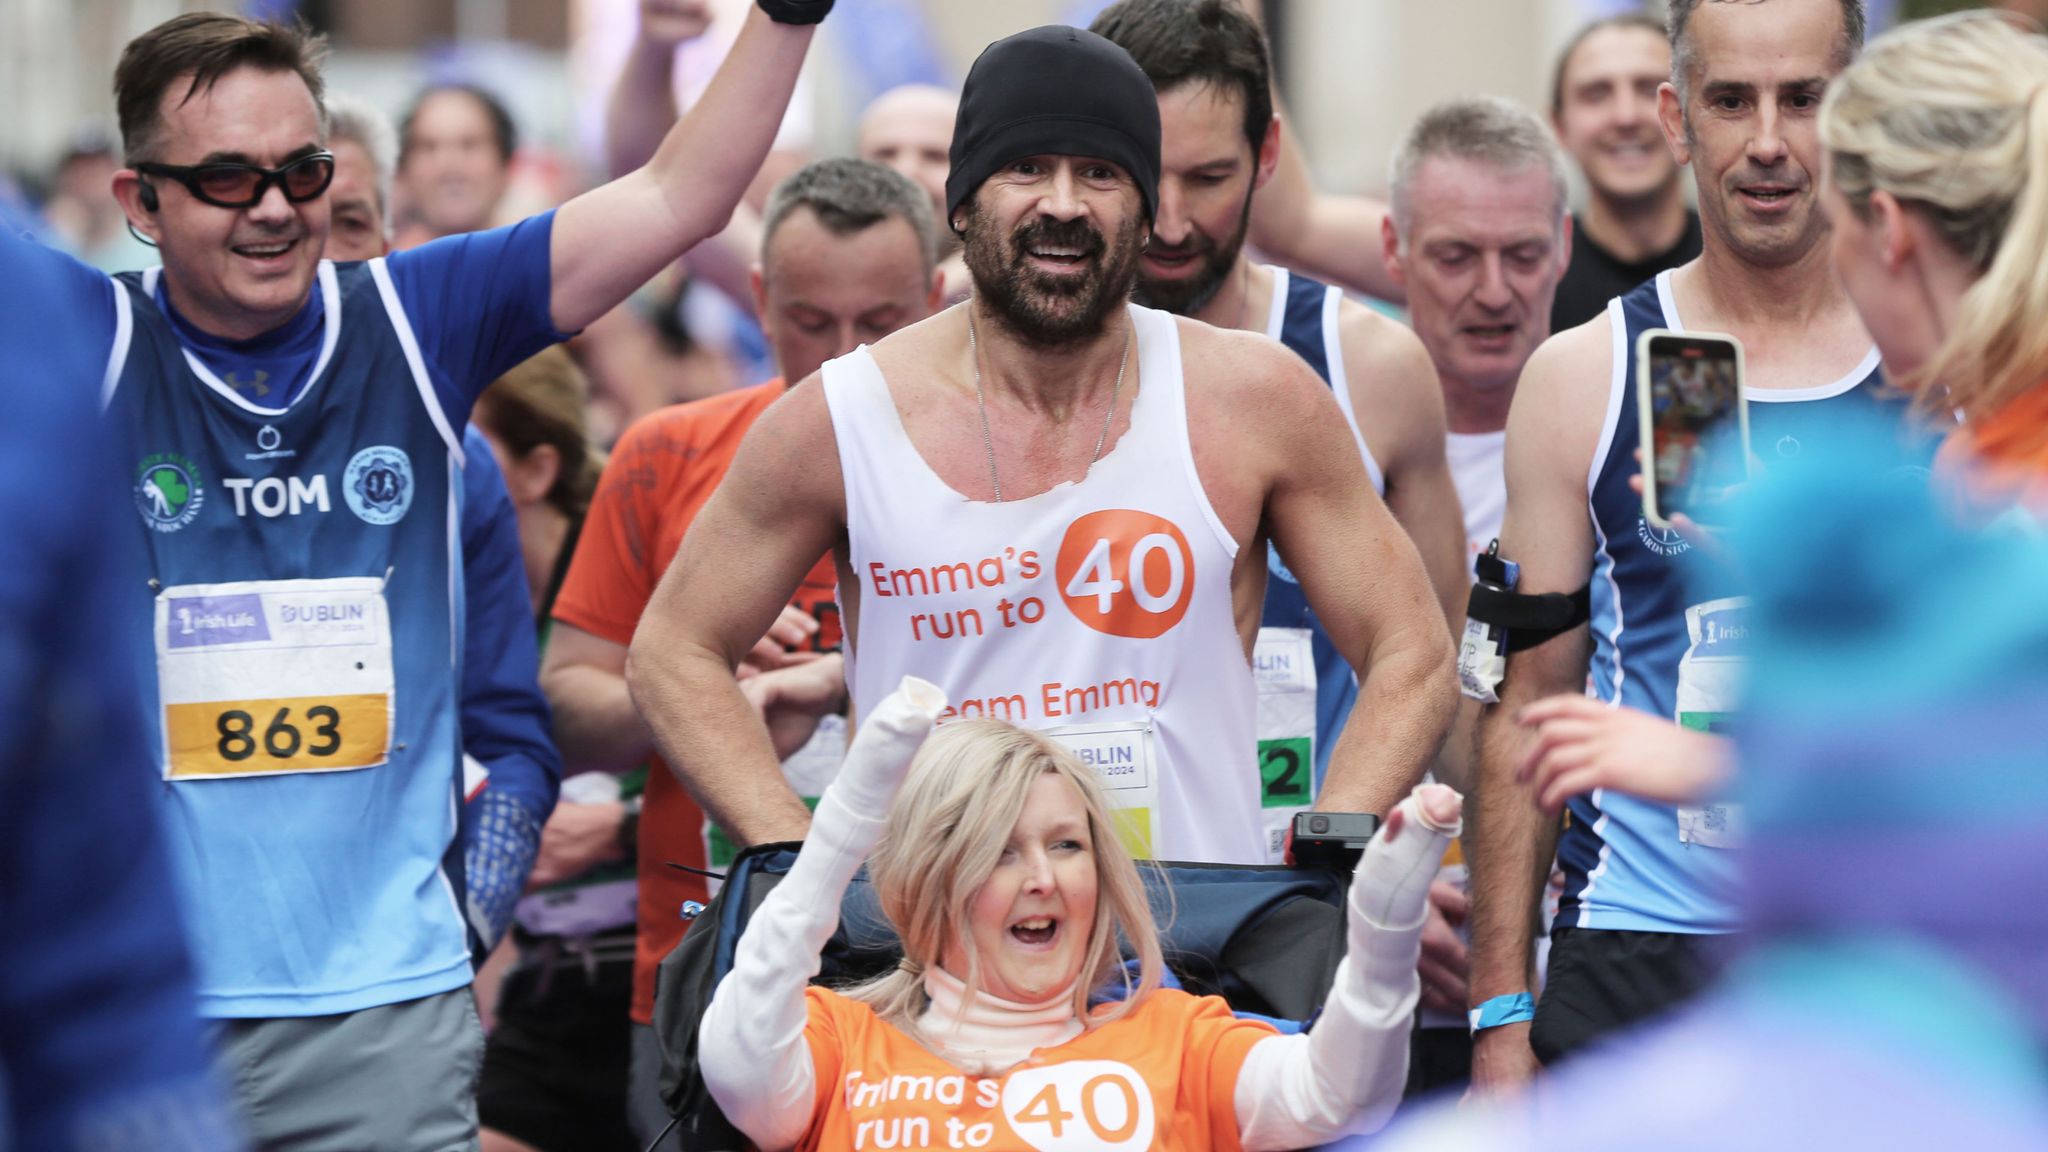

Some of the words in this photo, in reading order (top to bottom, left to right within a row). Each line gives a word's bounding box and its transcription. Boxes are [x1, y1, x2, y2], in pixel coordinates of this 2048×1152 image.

[223, 474, 332, 518] TOM
[869, 546, 1042, 597] Emma's
[1065, 532, 1186, 614] 40
[194, 614, 226, 629] Irish
[280, 603, 364, 624] DUBLIN
[911, 607, 983, 641] run
[996, 596, 1045, 629] to
[936, 693, 1027, 726] eam
[1041, 677, 1161, 718] Emma
[216, 704, 342, 762] 863
[1079, 745, 1133, 766] BLIN
[1107, 765, 1136, 776] 2024
[1266, 747, 1302, 797] 2
[1013, 1073, 1140, 1144] 40
[854, 1115, 931, 1151] run
[945, 1116, 995, 1149] to
